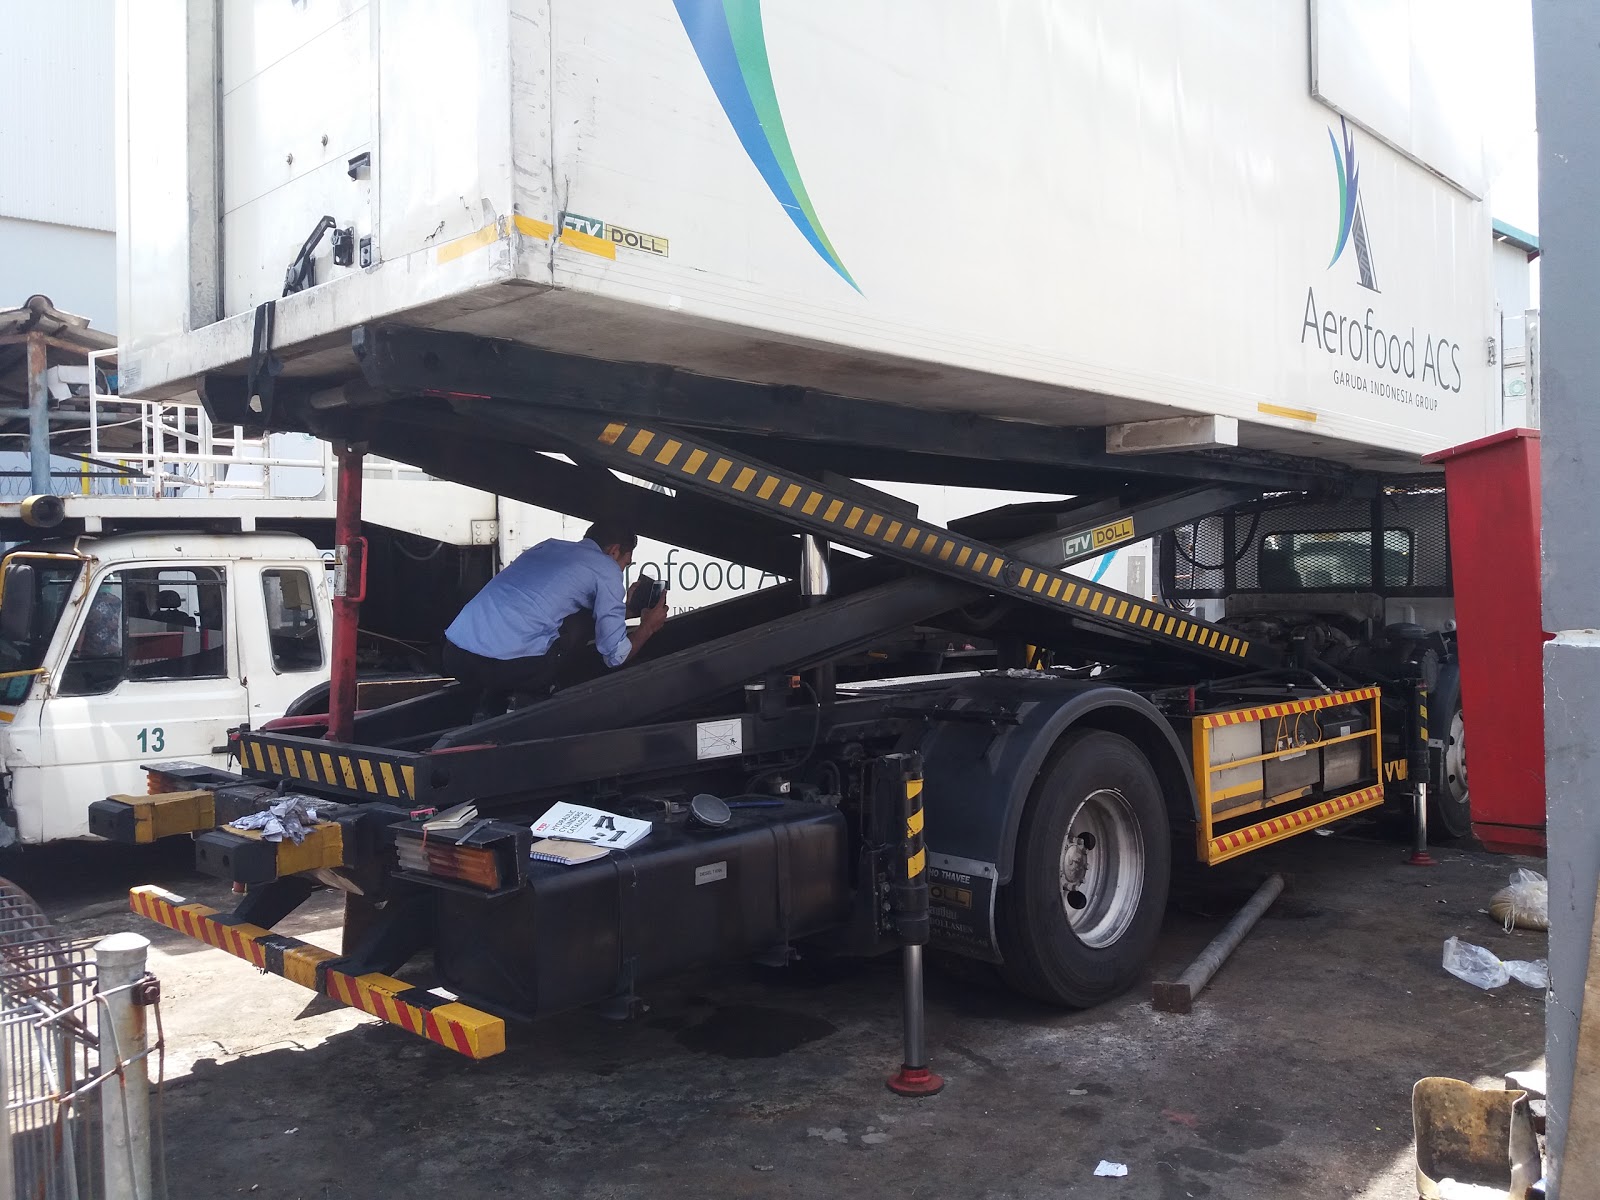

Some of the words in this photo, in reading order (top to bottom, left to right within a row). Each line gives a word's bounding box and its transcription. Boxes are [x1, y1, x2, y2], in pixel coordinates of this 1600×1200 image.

[611, 227, 663, 254] DOLL
[1301, 287, 1415, 379] Aerofood
[1422, 334, 1462, 393] ACS
[1333, 370, 1368, 392] GARUDA
[1370, 381, 1413, 405] INDONESIA
[1415, 394, 1438, 411] GROUP
[1096, 523, 1130, 544] DOLL
[625, 549, 745, 591] rofood
[137, 727, 165, 753] 13
[551, 810, 577, 831] HYDRAULIC
[567, 813, 592, 834] CATALOGUE
[929, 868, 939, 877] HO
[942, 871, 970, 884] THAVEE
[930, 886, 966, 905] OLL
